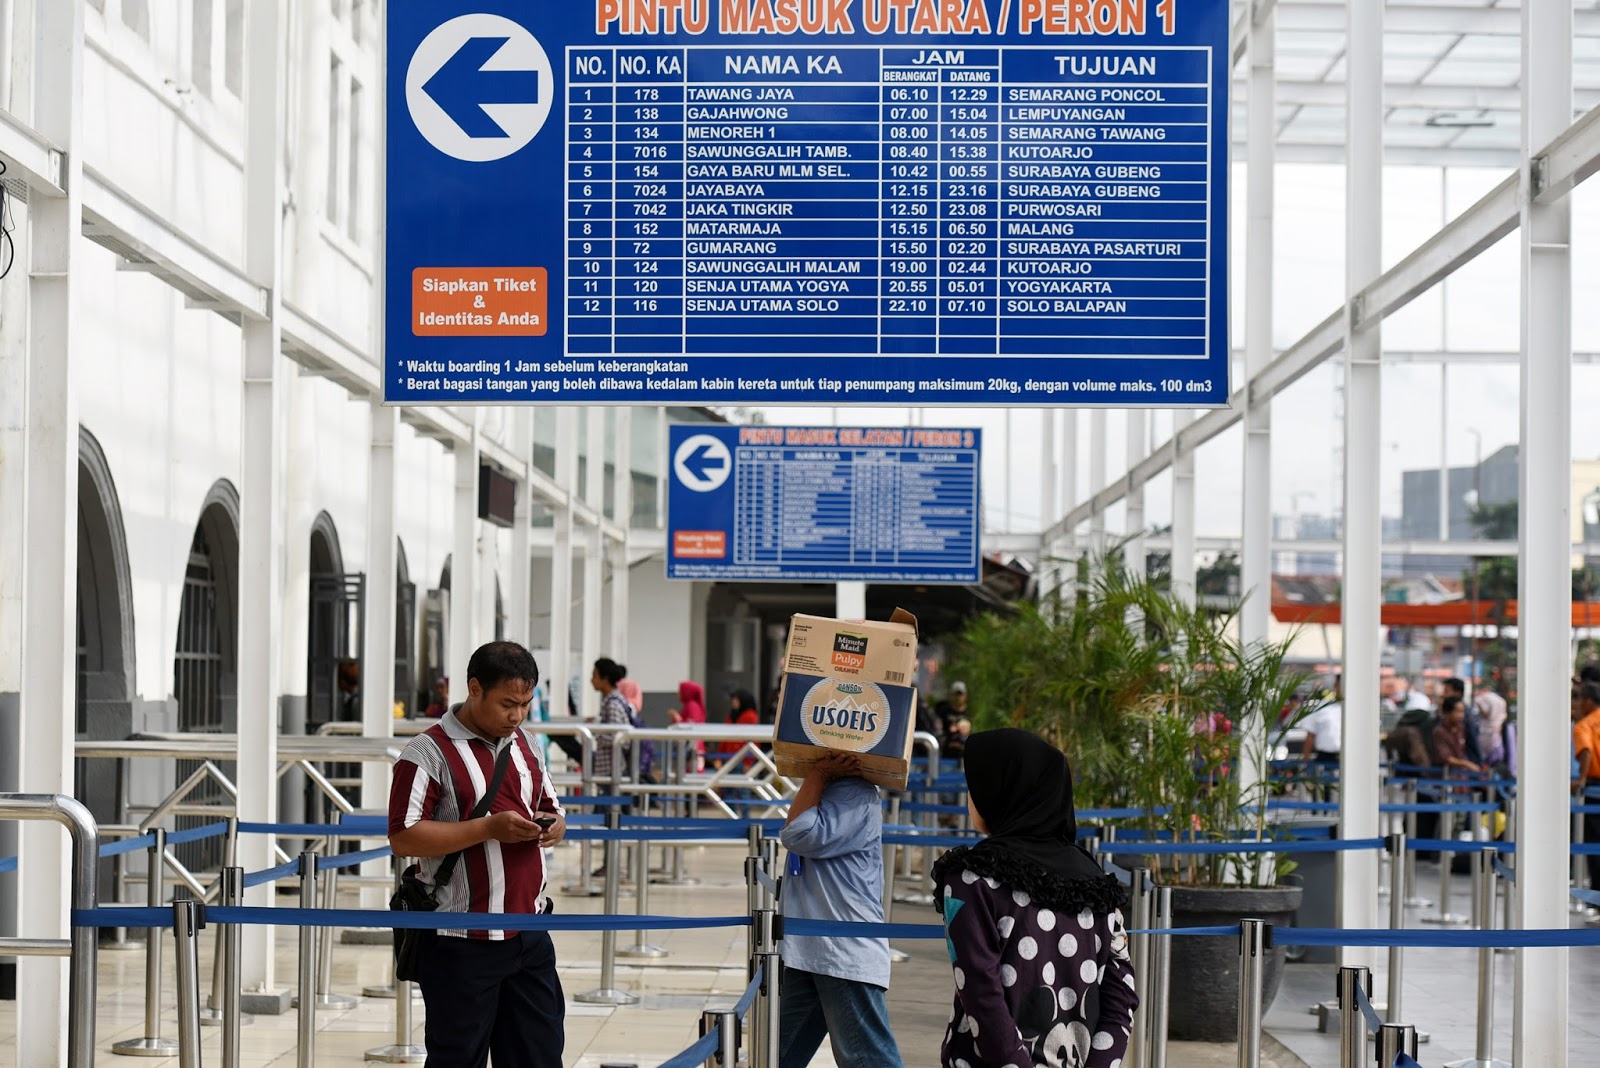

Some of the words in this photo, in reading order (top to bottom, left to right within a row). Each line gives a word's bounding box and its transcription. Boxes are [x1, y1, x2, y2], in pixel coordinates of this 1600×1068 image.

[596, 0, 709, 35] PINTU
[719, 0, 855, 35] MASUK
[862, 0, 992, 35] UTARA
[997, 0, 1011, 35] /
[1019, 0, 1146, 35] PERON
[1156, 0, 1175, 35] 1
[911, 50, 965, 64] JAM
[575, 56, 607, 75] NO.
[620, 56, 651, 74] NO.
[656, 56, 682, 74] KA
[725, 56, 801, 74] NAMA
[806, 56, 843, 74] KA
[1053, 56, 1156, 75] TUJUAN
[883, 70, 938, 83] BERANGKAT
[949, 71, 991, 82] DATANG
[584, 88, 591, 101] 1
[634, 88, 660, 101] 178
[687, 87, 753, 101] TAWANG
[755, 87, 795, 101] JAYA
[890, 88, 929, 101] 06.10
[949, 88, 988, 102] 12.29
[1008, 88, 1097, 102] SEMARANG
[1100, 88, 1166, 102] PONCOL
[583, 107, 593, 121] 2
[634, 107, 660, 120] 138
[687, 106, 789, 120] GAJAHWONG
[890, 107, 929, 120] 07.00
[949, 107, 988, 121] 15.04
[1008, 107, 1126, 121] LEMPUYANGAN
[583, 127, 593, 140] 3
[633, 126, 660, 140] 134
[687, 126, 764, 139] MENOREH
[768, 126, 775, 139] 1
[889, 126, 929, 140] 08.00
[949, 126, 988, 140] 14.05
[1008, 126, 1097, 140] SEMARANG
[1099, 127, 1166, 141] TAWANG
[582, 146, 593, 159] 4
[633, 145, 668, 159] 7016
[687, 145, 801, 158] SAWUNGGALIH
[804, 145, 852, 158] TAMB.
[889, 145, 929, 159] 08.40
[949, 145, 988, 159] 15.38
[1008, 145, 1094, 159] KUTOARJO
[583, 165, 593, 178] 5
[633, 165, 659, 178] 154
[686, 164, 729, 178] GAYA
[731, 164, 775, 178] BARU
[778, 164, 814, 177] MLM
[817, 164, 851, 178] SEL.
[890, 164, 929, 178] 10.42
[948, 165, 988, 178] 00.55
[1008, 164, 1092, 178] SURABAYA
[1094, 165, 1161, 179] GUBENG
[583, 184, 593, 197] 6
[633, 184, 668, 197] 7024
[686, 183, 765, 197] JAYABAYA
[890, 184, 929, 197] 12.15
[948, 184, 987, 197] 23.16
[1007, 184, 1092, 198] SURABAYA
[1094, 184, 1161, 198] GUBENG
[582, 203, 592, 216] 7
[633, 203, 667, 216] 7042
[686, 203, 729, 216] JAKA
[730, 203, 794, 216] TINGKIR
[890, 203, 928, 216] 12.50
[948, 203, 987, 216] 23.08
[1008, 203, 1102, 217] PURWOSARI
[582, 222, 592, 236] 8
[633, 222, 659, 235] 152
[687, 222, 782, 235] MATARMAJA
[889, 222, 928, 235] 15.15
[948, 222, 987, 236] 06.50
[1007, 222, 1075, 236] MALANG
[582, 242, 592, 255] 9
[632, 241, 650, 254] 72
[686, 241, 777, 255] GUMARANG
[889, 241, 928, 255] 15.50
[948, 242, 987, 255] 02.20
[1007, 242, 1091, 255] SURABAYA
[1094, 242, 1182, 256] PASARTURI
[583, 261, 601, 274] 10
[633, 261, 659, 274] 124
[686, 260, 801, 274] SAWUNGGALIH
[804, 260, 861, 273] MALAM
[889, 261, 928, 274] 19.00
[948, 261, 987, 274] 02.44
[1007, 261, 1093, 275] KUTOARJO
[422, 278, 489, 293] Siapkan
[493, 277, 537, 292] Tiket
[583, 280, 598, 293] 11
[633, 280, 659, 293] 120
[686, 279, 737, 293] SENJA
[740, 280, 794, 293] UTAMA
[796, 279, 850, 293] YOGYA
[888, 280, 928, 293] 20.55
[947, 280, 985, 293] 05.01
[1006, 280, 1113, 294] YOGYAKARTA
[472, 294, 486, 309] &
[583, 299, 600, 312] 12
[633, 299, 658, 312] 116
[686, 299, 737, 312] SENJA
[740, 299, 794, 312] UTAMA
[796, 299, 840, 312] SOLO
[888, 299, 927, 312] 22.10
[947, 299, 986, 313] 07.10
[1006, 299, 1051, 313] SOLO
[1053, 300, 1127, 313] BALAPAN
[419, 311, 493, 326] Identitas
[497, 311, 540, 326] Anda
[406, 359, 446, 373] Waktu
[448, 360, 501, 375] boarding
[503, 359, 511, 373] 1
[514, 359, 541, 373] Jam
[543, 359, 595, 373] sebelum
[597, 360, 689, 375] keberangkatan
[406, 377, 441, 391] Berat
[443, 378, 483, 392] bagasi
[485, 378, 528, 392] tangan
[530, 380, 561, 393] yang
[562, 377, 597, 390] boleh
[599, 377, 644, 390] dibawa
[646, 377, 698, 390] kedalam
[700, 377, 735, 390] kabin
[737, 377, 778, 390] kereta
[780, 377, 816, 391] untuk
[817, 378, 843, 392] tiap
[844, 380, 916, 394] penumpang
[918, 377, 985, 391] maksimum
[987, 378, 1022, 393] 20kg,
[1024, 379, 1070, 393] dengan
[1071, 378, 1117, 392] volume
[1119, 379, 1157, 392] maks.
[1160, 379, 1183, 393] 100
[1185, 379, 1213, 393] dm3
[739, 428, 784, 445] PINTU
[785, 428, 838, 446] MASUK
[839, 428, 904, 447] SELATAN
[963, 430, 975, 448] 3
[838, 636, 865, 647] Minute
[840, 643, 860, 652] Maid
[835, 653, 863, 667] Pulpy
[834, 666, 860, 674] ORANGE
[812, 705, 878, 732] USOEIS
[820, 729, 845, 739] Drinking
[845, 732, 864, 741] Water
